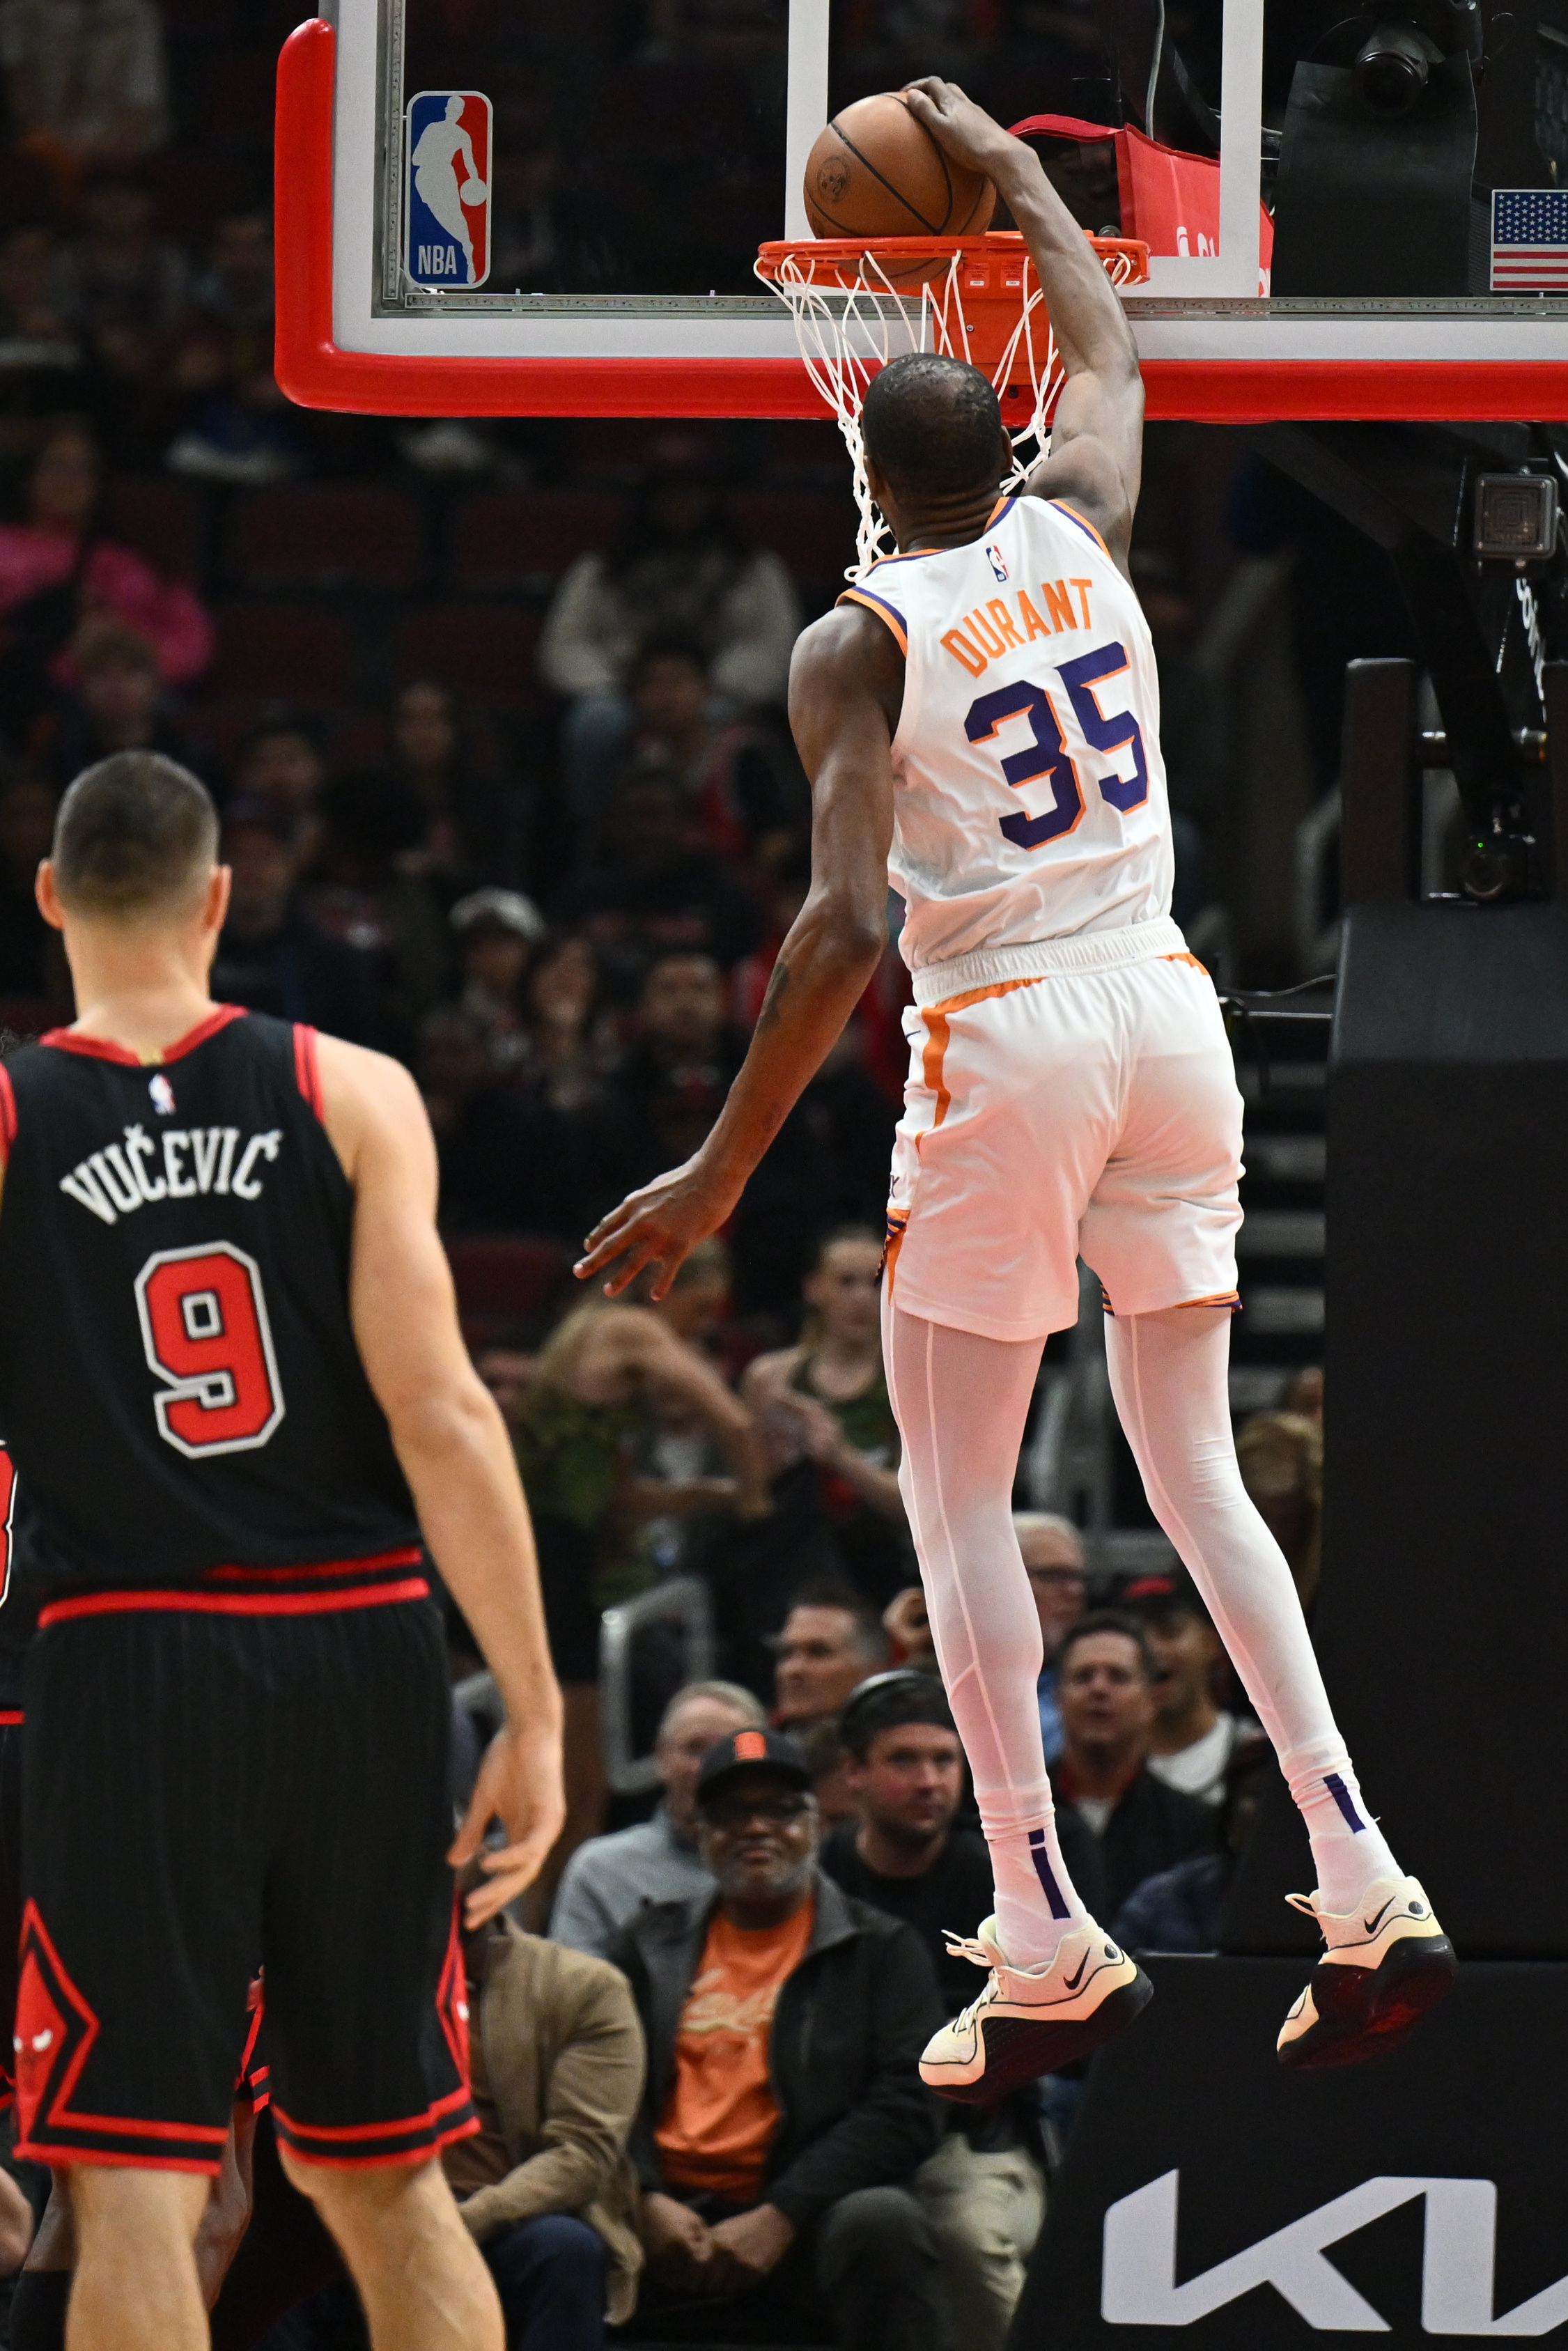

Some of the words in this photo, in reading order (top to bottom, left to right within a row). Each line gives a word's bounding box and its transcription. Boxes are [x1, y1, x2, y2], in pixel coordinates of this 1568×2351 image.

[418, 245, 457, 274] NBA
[940, 578, 1093, 678] DURANT
[963, 641, 1149, 852] 35
[59, 1122, 283, 1225] VUČEVIĆ
[134, 1240, 286, 1460] 9
